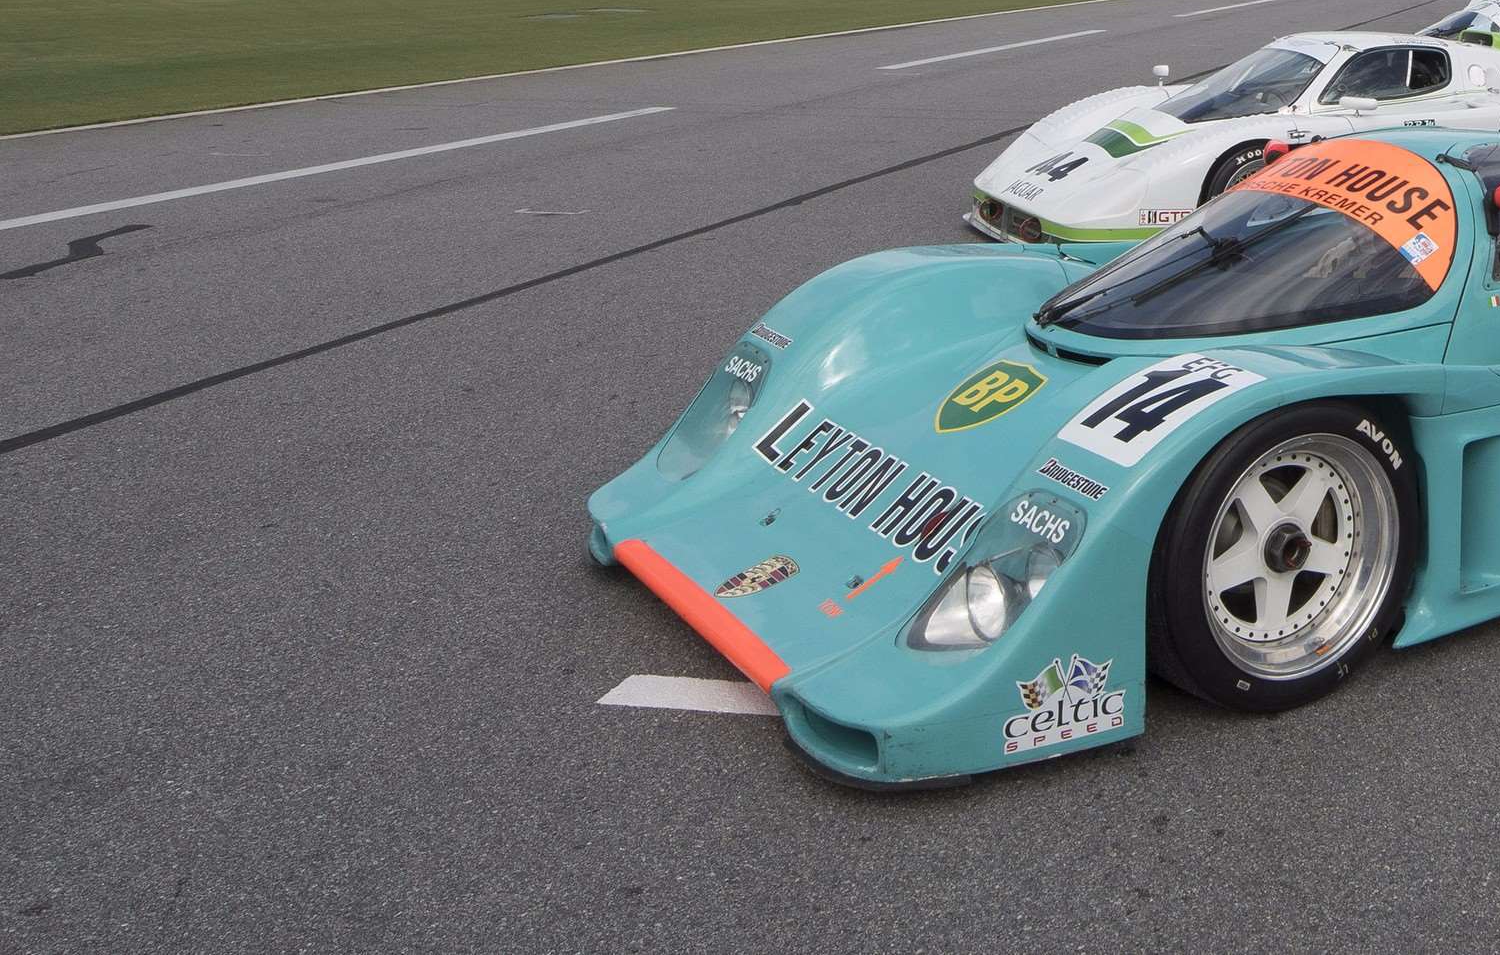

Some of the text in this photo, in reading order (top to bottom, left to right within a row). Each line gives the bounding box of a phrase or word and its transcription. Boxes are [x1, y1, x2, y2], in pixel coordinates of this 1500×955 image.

[1267, 156, 1452, 231] TON HOUSE
[1297, 186, 1384, 226] KREMER
[725, 356, 762, 382] SACHS
[951, 369, 1029, 414] BP
[1080, 369, 1230, 444] 14
[752, 398, 909, 519] LEYTON
[1355, 418, 1404, 471] AVON
[1037, 456, 1110, 502] BRIDGESTONE
[1010, 500, 1071, 544] SACHS
[1006, 716, 1123, 754] SPEED
